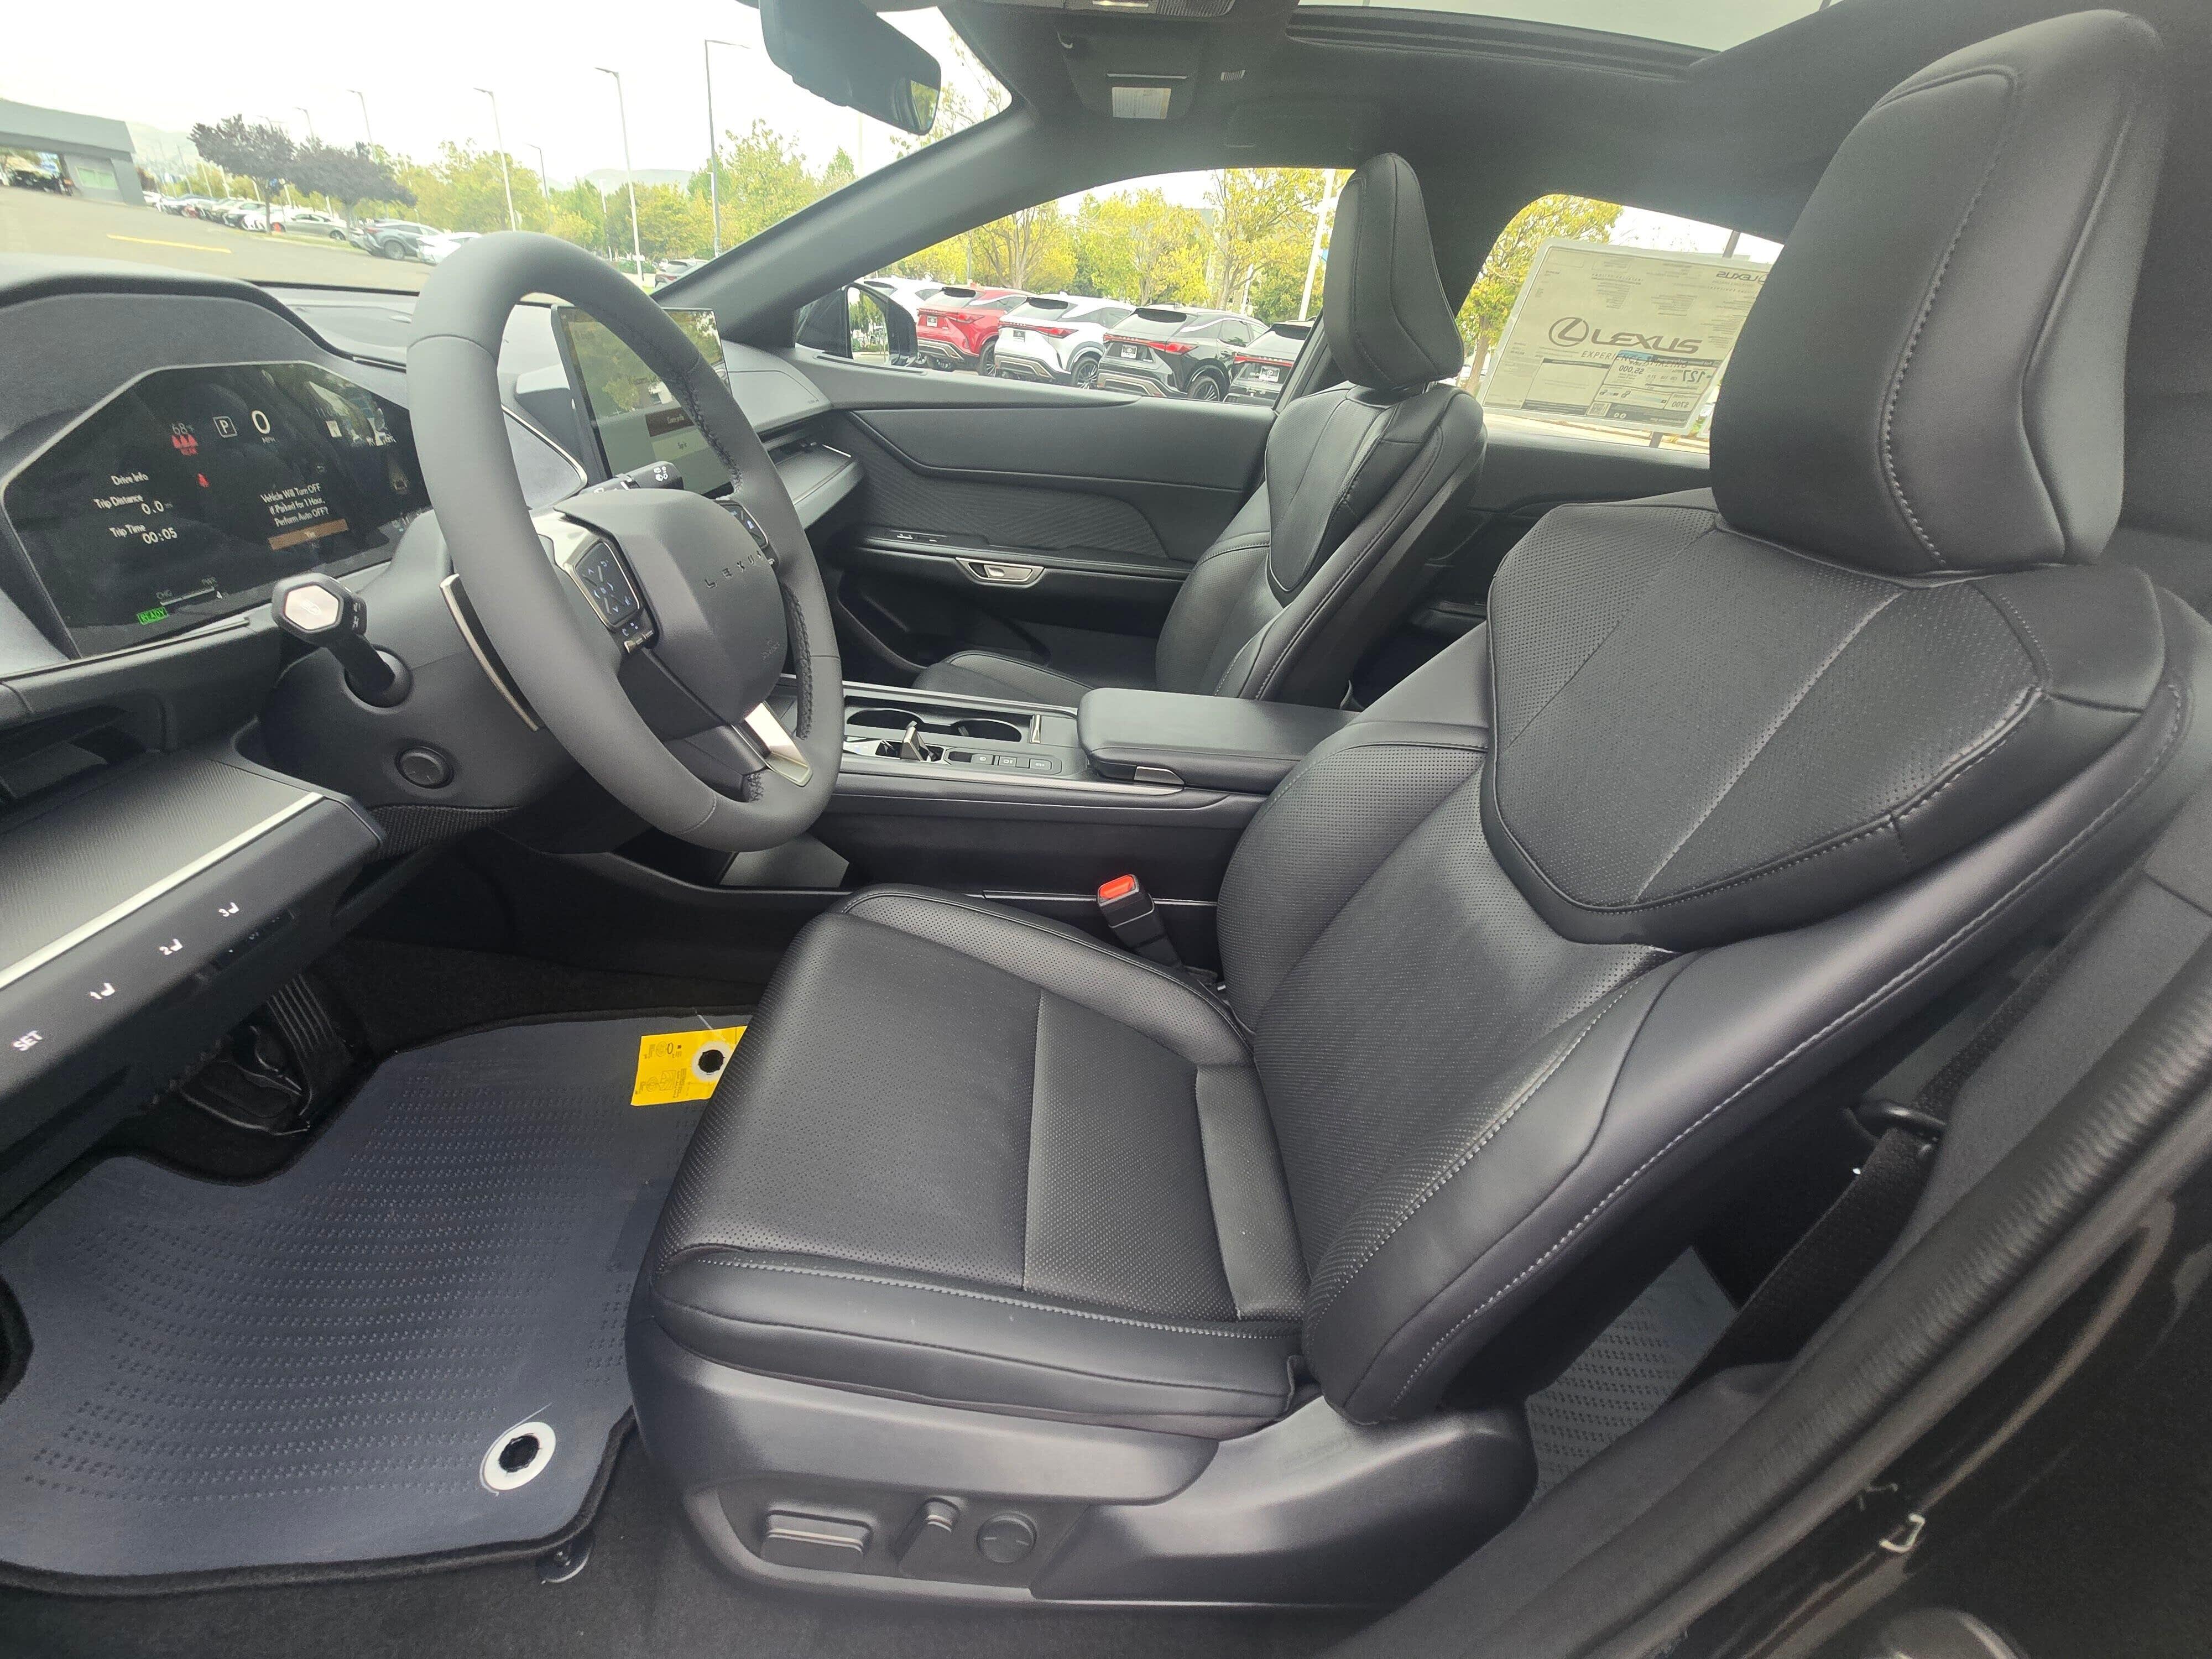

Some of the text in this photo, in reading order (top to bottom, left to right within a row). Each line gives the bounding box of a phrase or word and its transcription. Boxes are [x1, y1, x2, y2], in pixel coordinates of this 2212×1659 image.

[1591, 328, 1703, 354] LEXUS
[1581, 351, 1642, 363] EXPERIENCE
[220, 419, 229, 434] P
[252, 410, 270, 434] 0
[111, 474, 133, 486] Drive
[281, 489, 296, 498] Will
[294, 487, 309, 496] Turn
[307, 483, 321, 494] OFF
[93, 495, 144, 509] Trip Distance
[141, 500, 164, 515] 0.0
[298, 512, 312, 521] Auto
[311, 507, 329, 518] OFF?
[109, 524, 146, 538] Trip Time
[142, 527, 178, 544] 00:05
[159, 946, 173, 956] 2
[12, 1030, 43, 1051] SET
